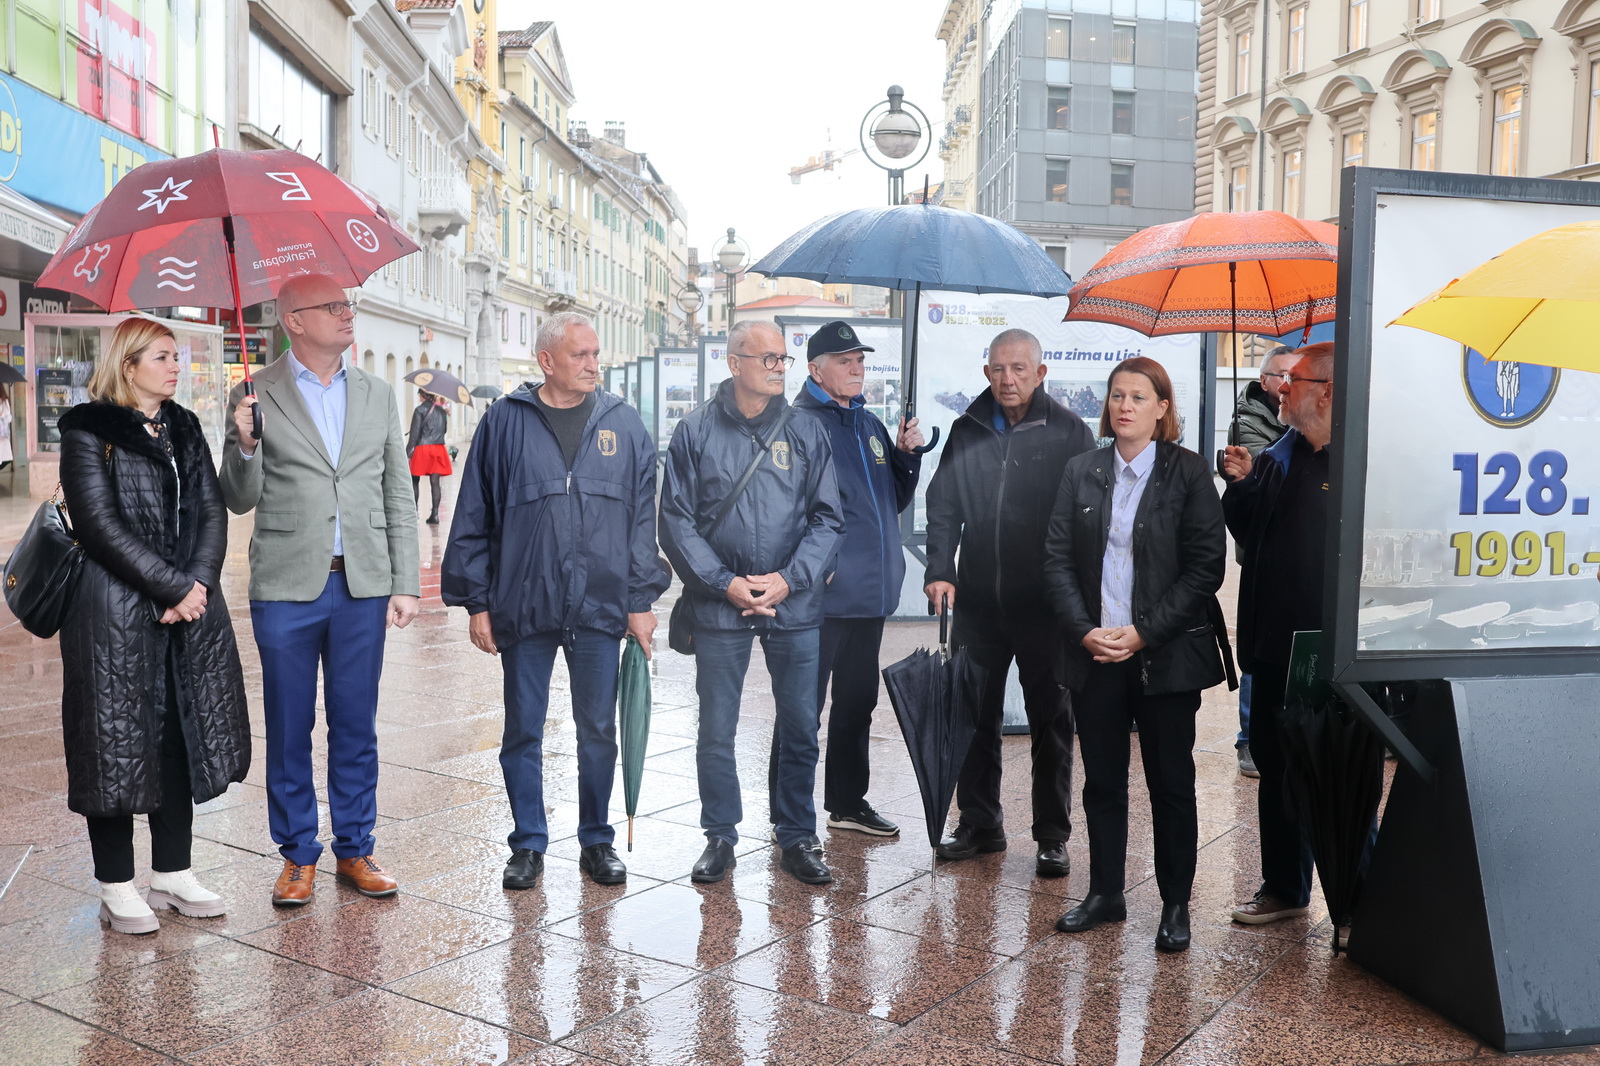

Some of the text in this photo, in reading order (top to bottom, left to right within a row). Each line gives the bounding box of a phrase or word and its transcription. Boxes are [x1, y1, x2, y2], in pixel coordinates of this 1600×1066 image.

[0, 109, 22, 157] Di
[31, 224, 57, 251] CENTAR
[944, 304, 970, 315] 128.
[1065, 348, 1101, 361] zima
[1104, 351, 1113, 361] u
[872, 364, 900, 374] bojištu
[1453, 448, 1590, 517] 128.
